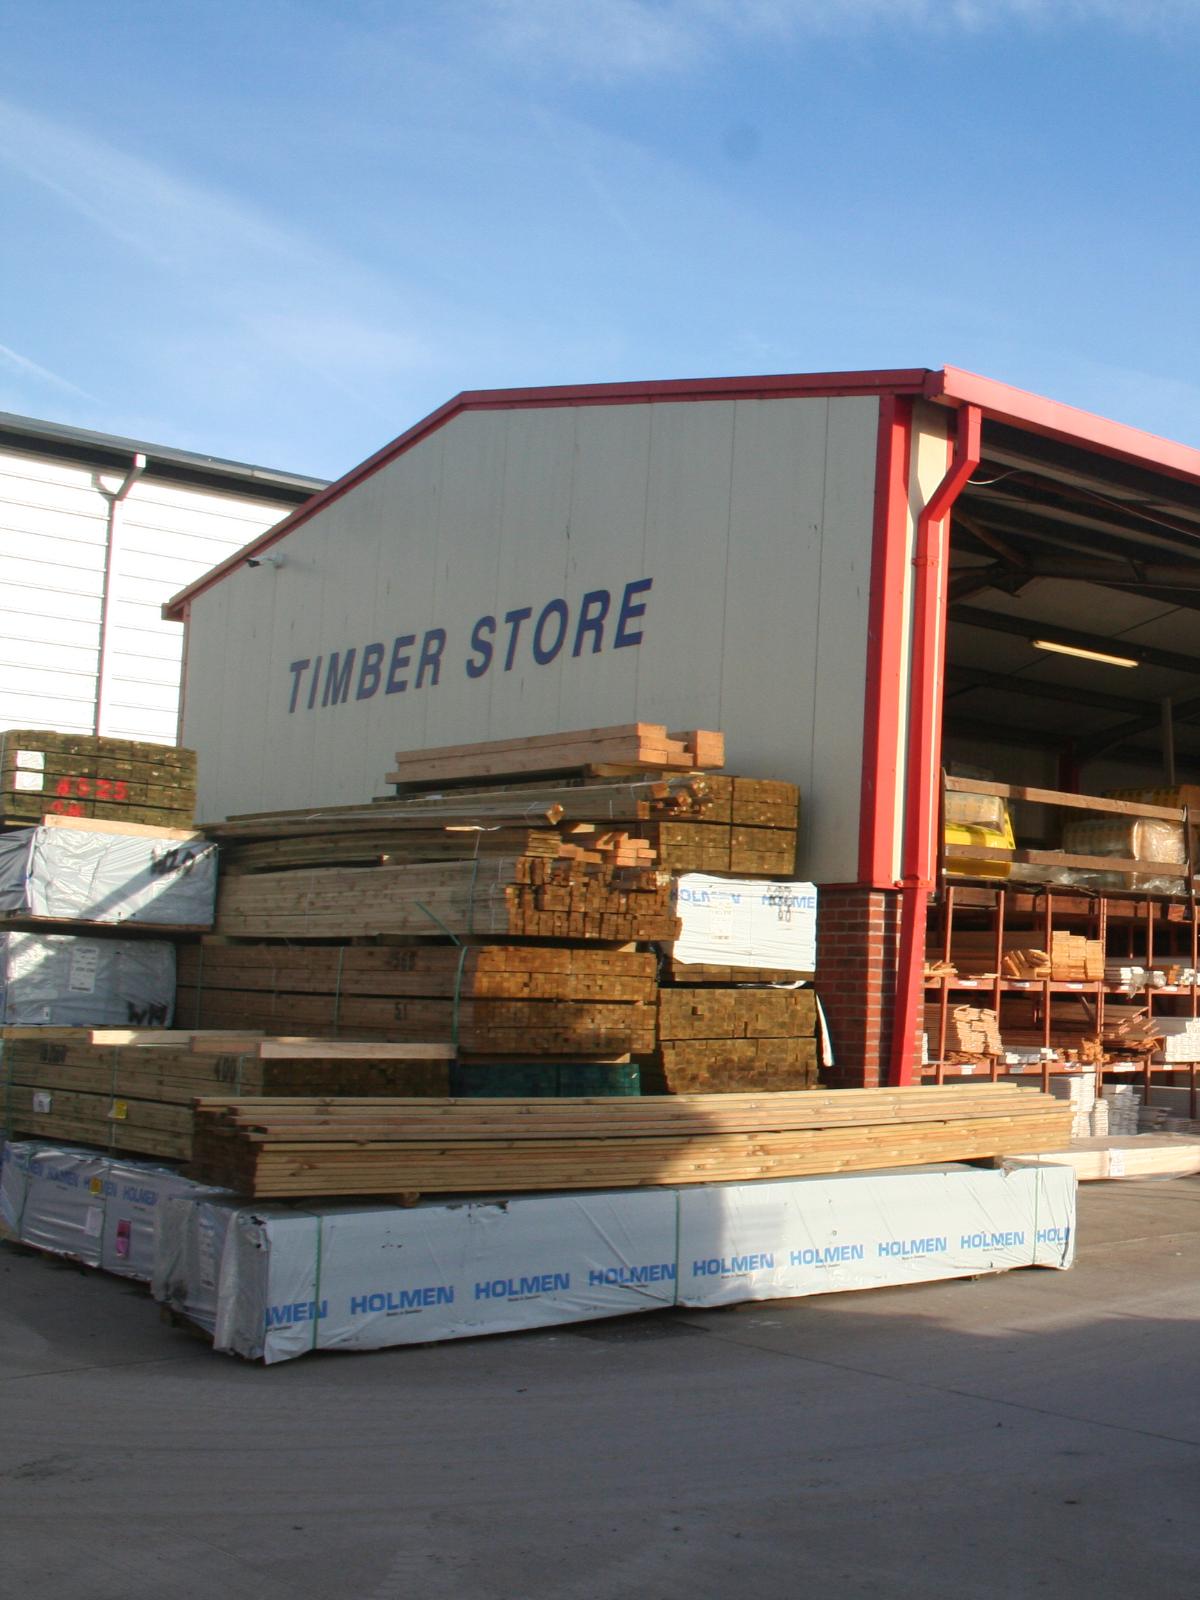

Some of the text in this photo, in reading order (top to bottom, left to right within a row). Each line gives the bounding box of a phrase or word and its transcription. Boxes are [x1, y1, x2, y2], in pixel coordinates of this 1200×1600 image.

[288, 577, 654, 714] TIMBER STORE
[266, 1300, 328, 1327] MEN
[350, 1286, 455, 1315] HOLMEN
[474, 1272, 570, 1300] HOLMEN
[588, 1263, 676, 1287] HOLMEN
[692, 1252, 775, 1277] HOLMEN
[790, 1244, 864, 1266] HOLMEN
[878, 1236, 947, 1257] HOLMEN
[959, 1231, 1025, 1250] HOLMEN
